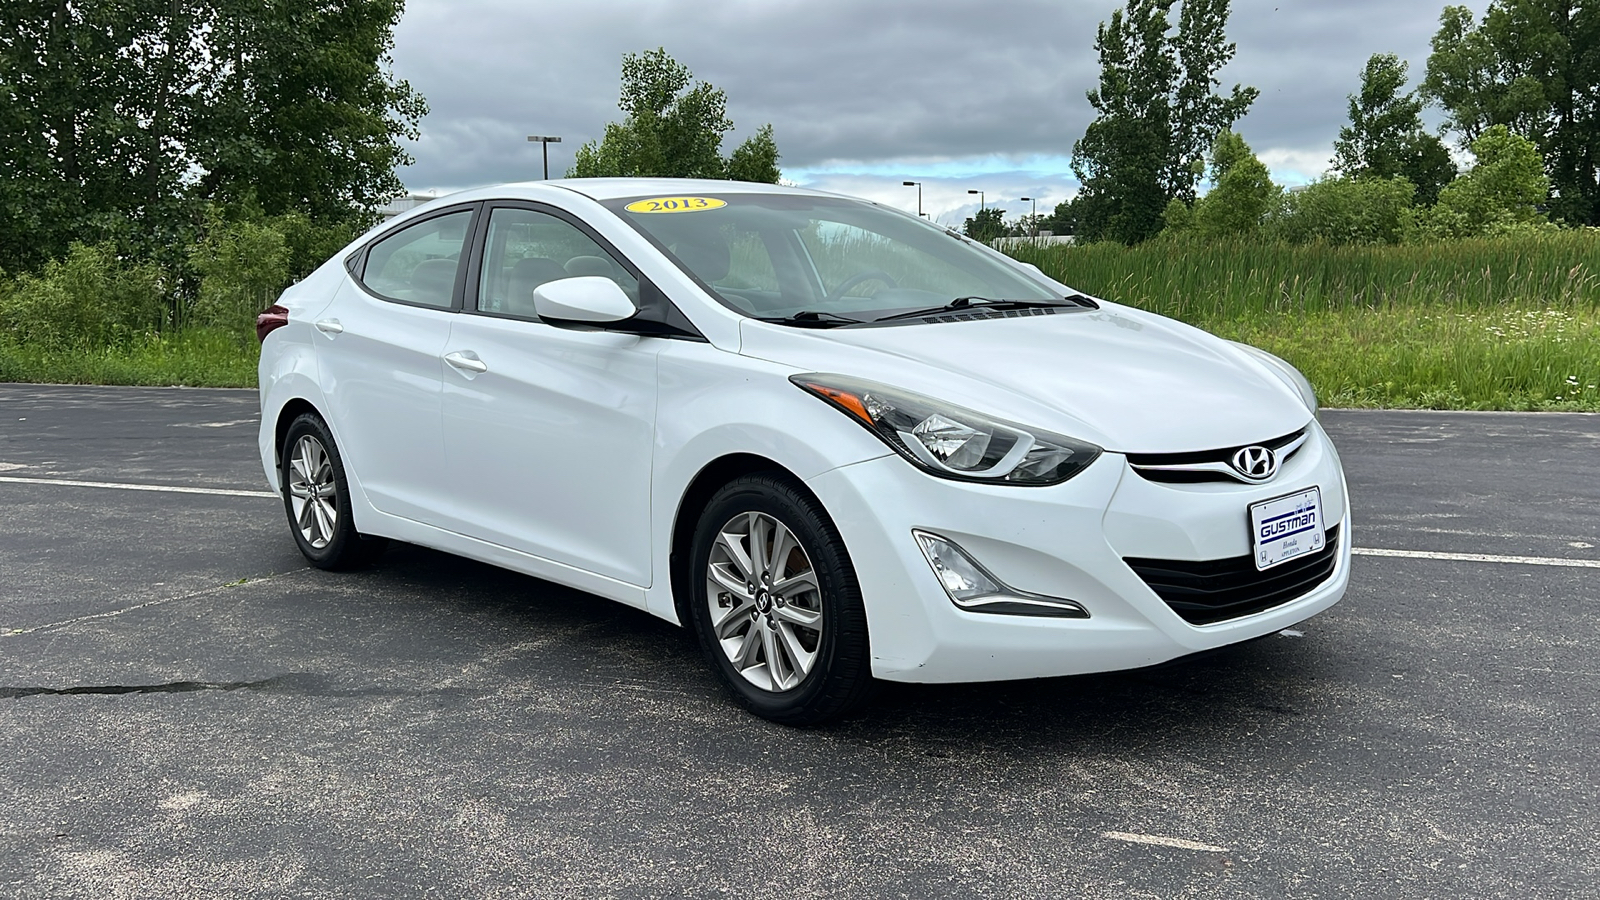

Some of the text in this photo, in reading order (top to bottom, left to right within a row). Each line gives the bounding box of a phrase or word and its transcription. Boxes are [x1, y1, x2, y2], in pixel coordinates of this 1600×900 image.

[646, 199, 708, 212] 2013
[1282, 538, 1298, 549] Honda
[1281, 546, 1300, 557] APPLETON
